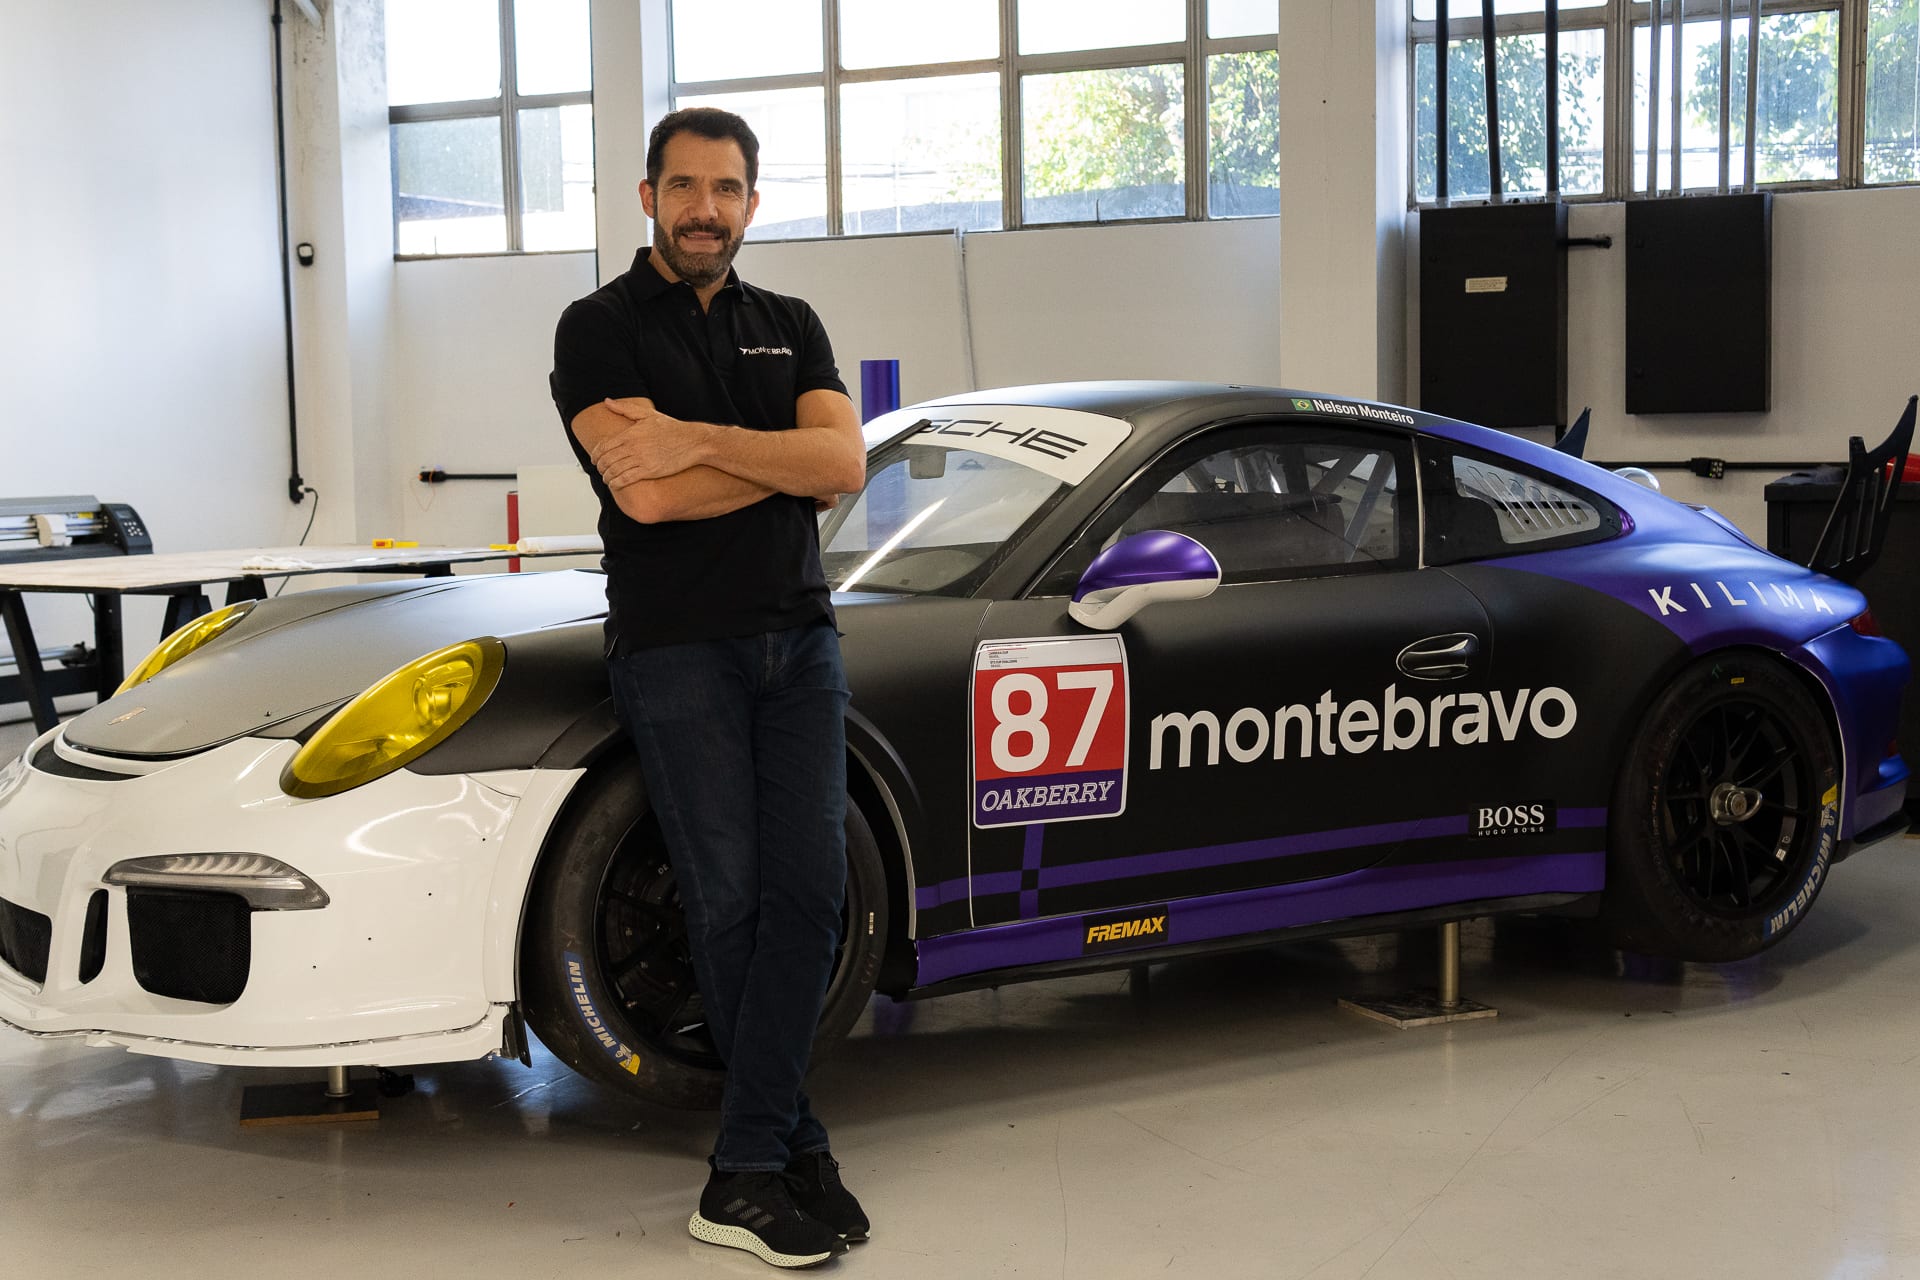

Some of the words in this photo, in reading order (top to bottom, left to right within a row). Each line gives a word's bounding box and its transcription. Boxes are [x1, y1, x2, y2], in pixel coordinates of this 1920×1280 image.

[748, 346, 792, 355] MONEBRAO
[1312, 399, 1359, 416] Nelson
[1358, 404, 1415, 425] Monteiro
[1648, 581, 1834, 616] KILIMA
[990, 669, 1114, 773] 87
[1149, 683, 1578, 770] montebravo
[981, 780, 1115, 812] OAKBERRY
[1478, 804, 1545, 828] BOSS
[1513, 826, 1544, 834] BOSS
[1770, 832, 1832, 935] MICHELIN
[1086, 915, 1166, 944] FREMAX
[568, 961, 617, 1048] MICHELIN
